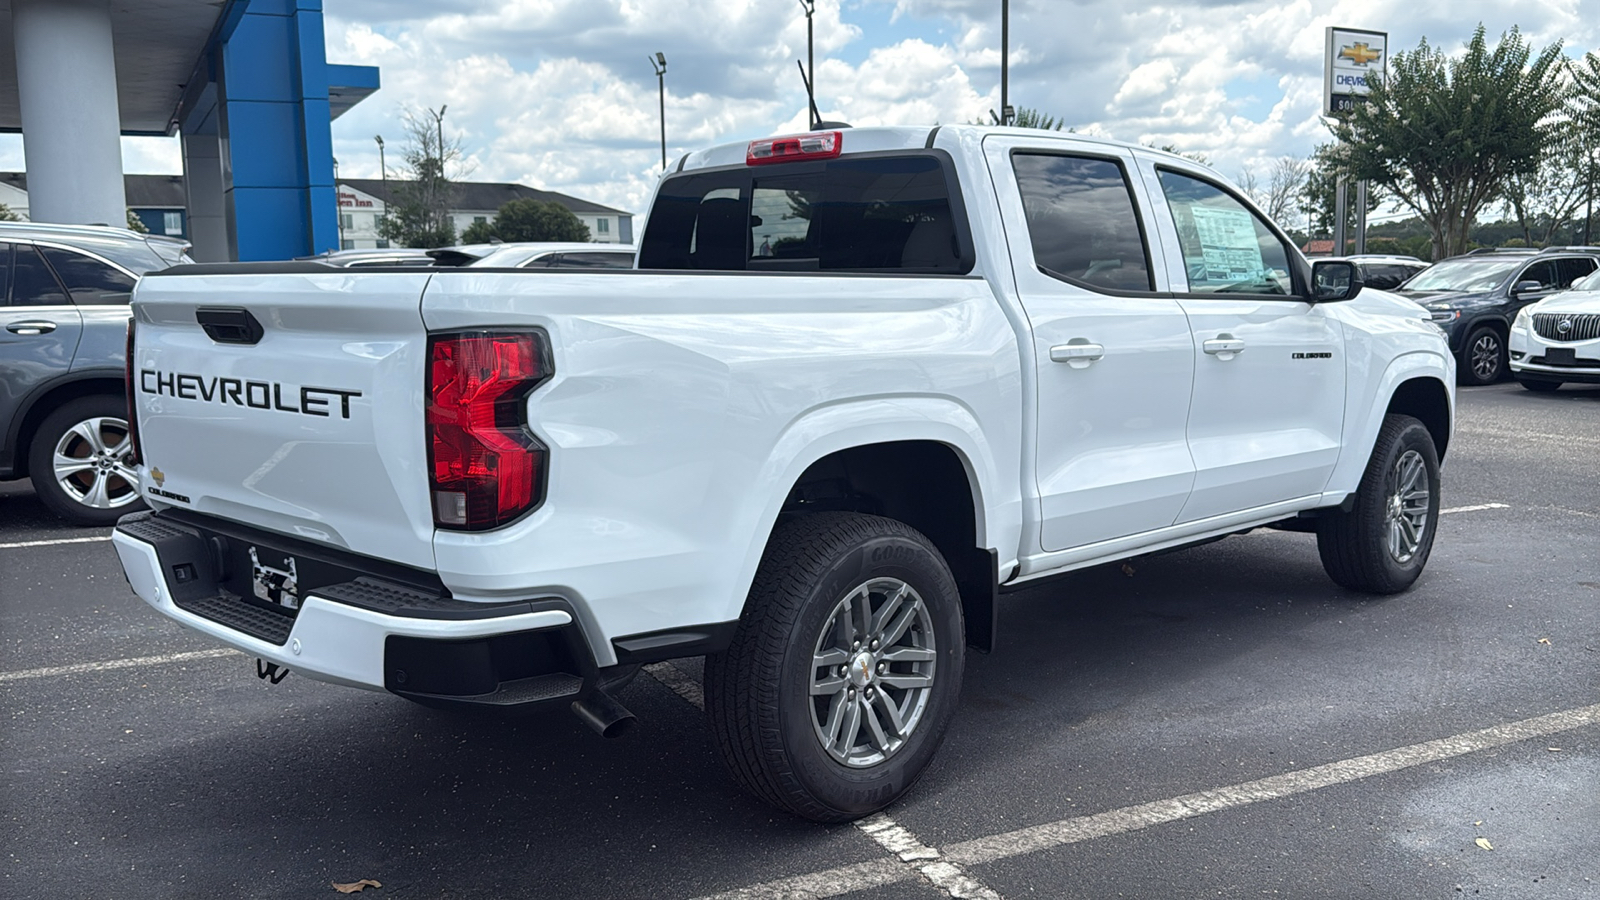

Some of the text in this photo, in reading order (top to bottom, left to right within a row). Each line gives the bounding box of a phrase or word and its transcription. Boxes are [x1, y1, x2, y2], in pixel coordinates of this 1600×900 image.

[1336, 75, 1371, 87] CHEVRO
[355, 199, 374, 207] Inn
[1291, 352, 1332, 360] COLORADO
[141, 368, 363, 419] CHEVROLET
[148, 486, 191, 504] COLORADO
